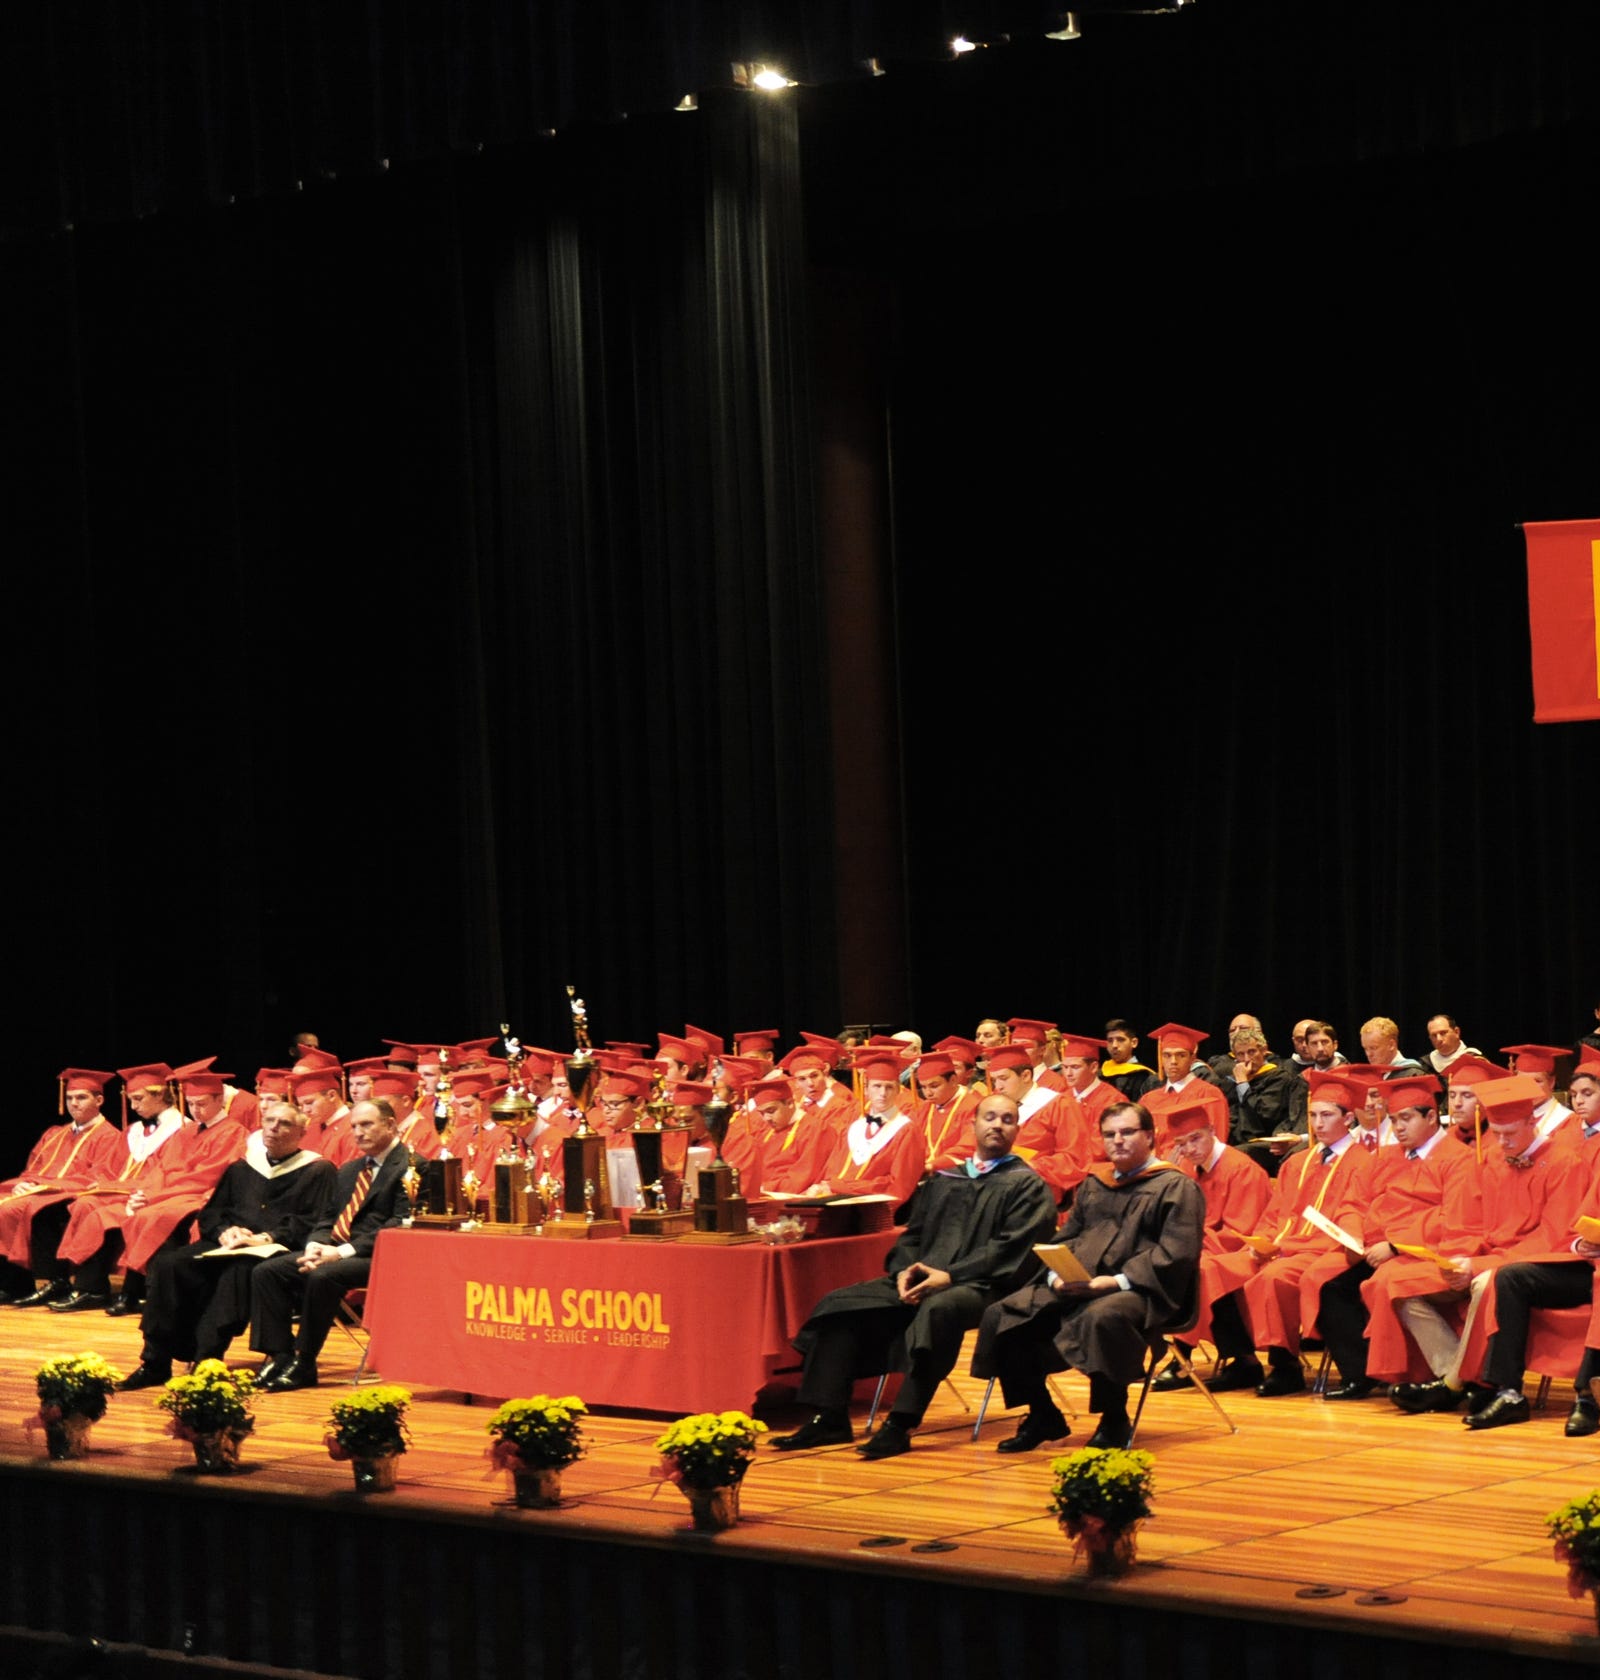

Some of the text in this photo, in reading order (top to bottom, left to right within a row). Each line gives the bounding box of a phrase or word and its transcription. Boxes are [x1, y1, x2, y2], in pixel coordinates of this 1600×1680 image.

[466, 1281, 670, 1334] PALMA SCHOOL
[465, 1321, 671, 1349] KNOWLEDGE SERVICE LEADERSHIP
